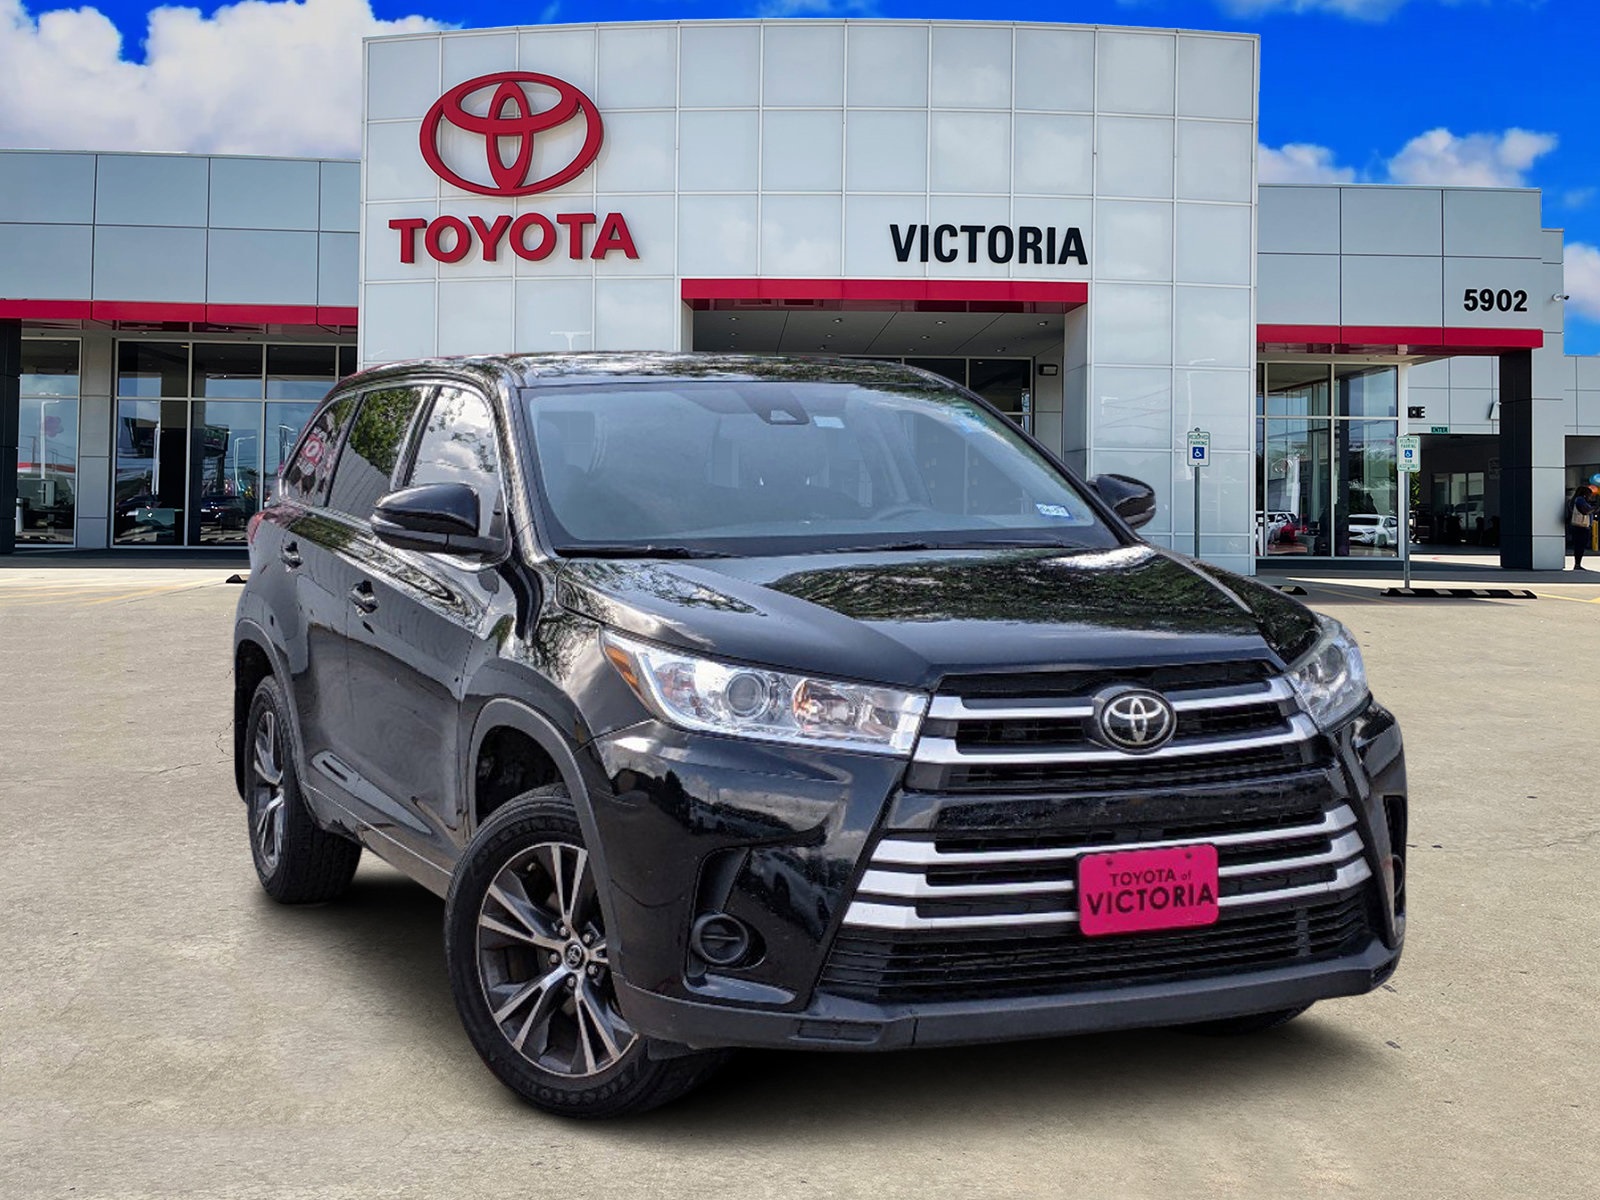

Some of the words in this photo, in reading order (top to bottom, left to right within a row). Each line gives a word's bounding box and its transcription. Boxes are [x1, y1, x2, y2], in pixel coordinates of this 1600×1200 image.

[389, 212, 638, 264] TOYOTA
[889, 223, 1089, 266] VICTORIA
[1463, 288, 1528, 312] 5902
[1110, 868, 1176, 887] TOYOTA
[1181, 870, 1192, 881] of
[1086, 883, 1215, 916] VICTORIA
